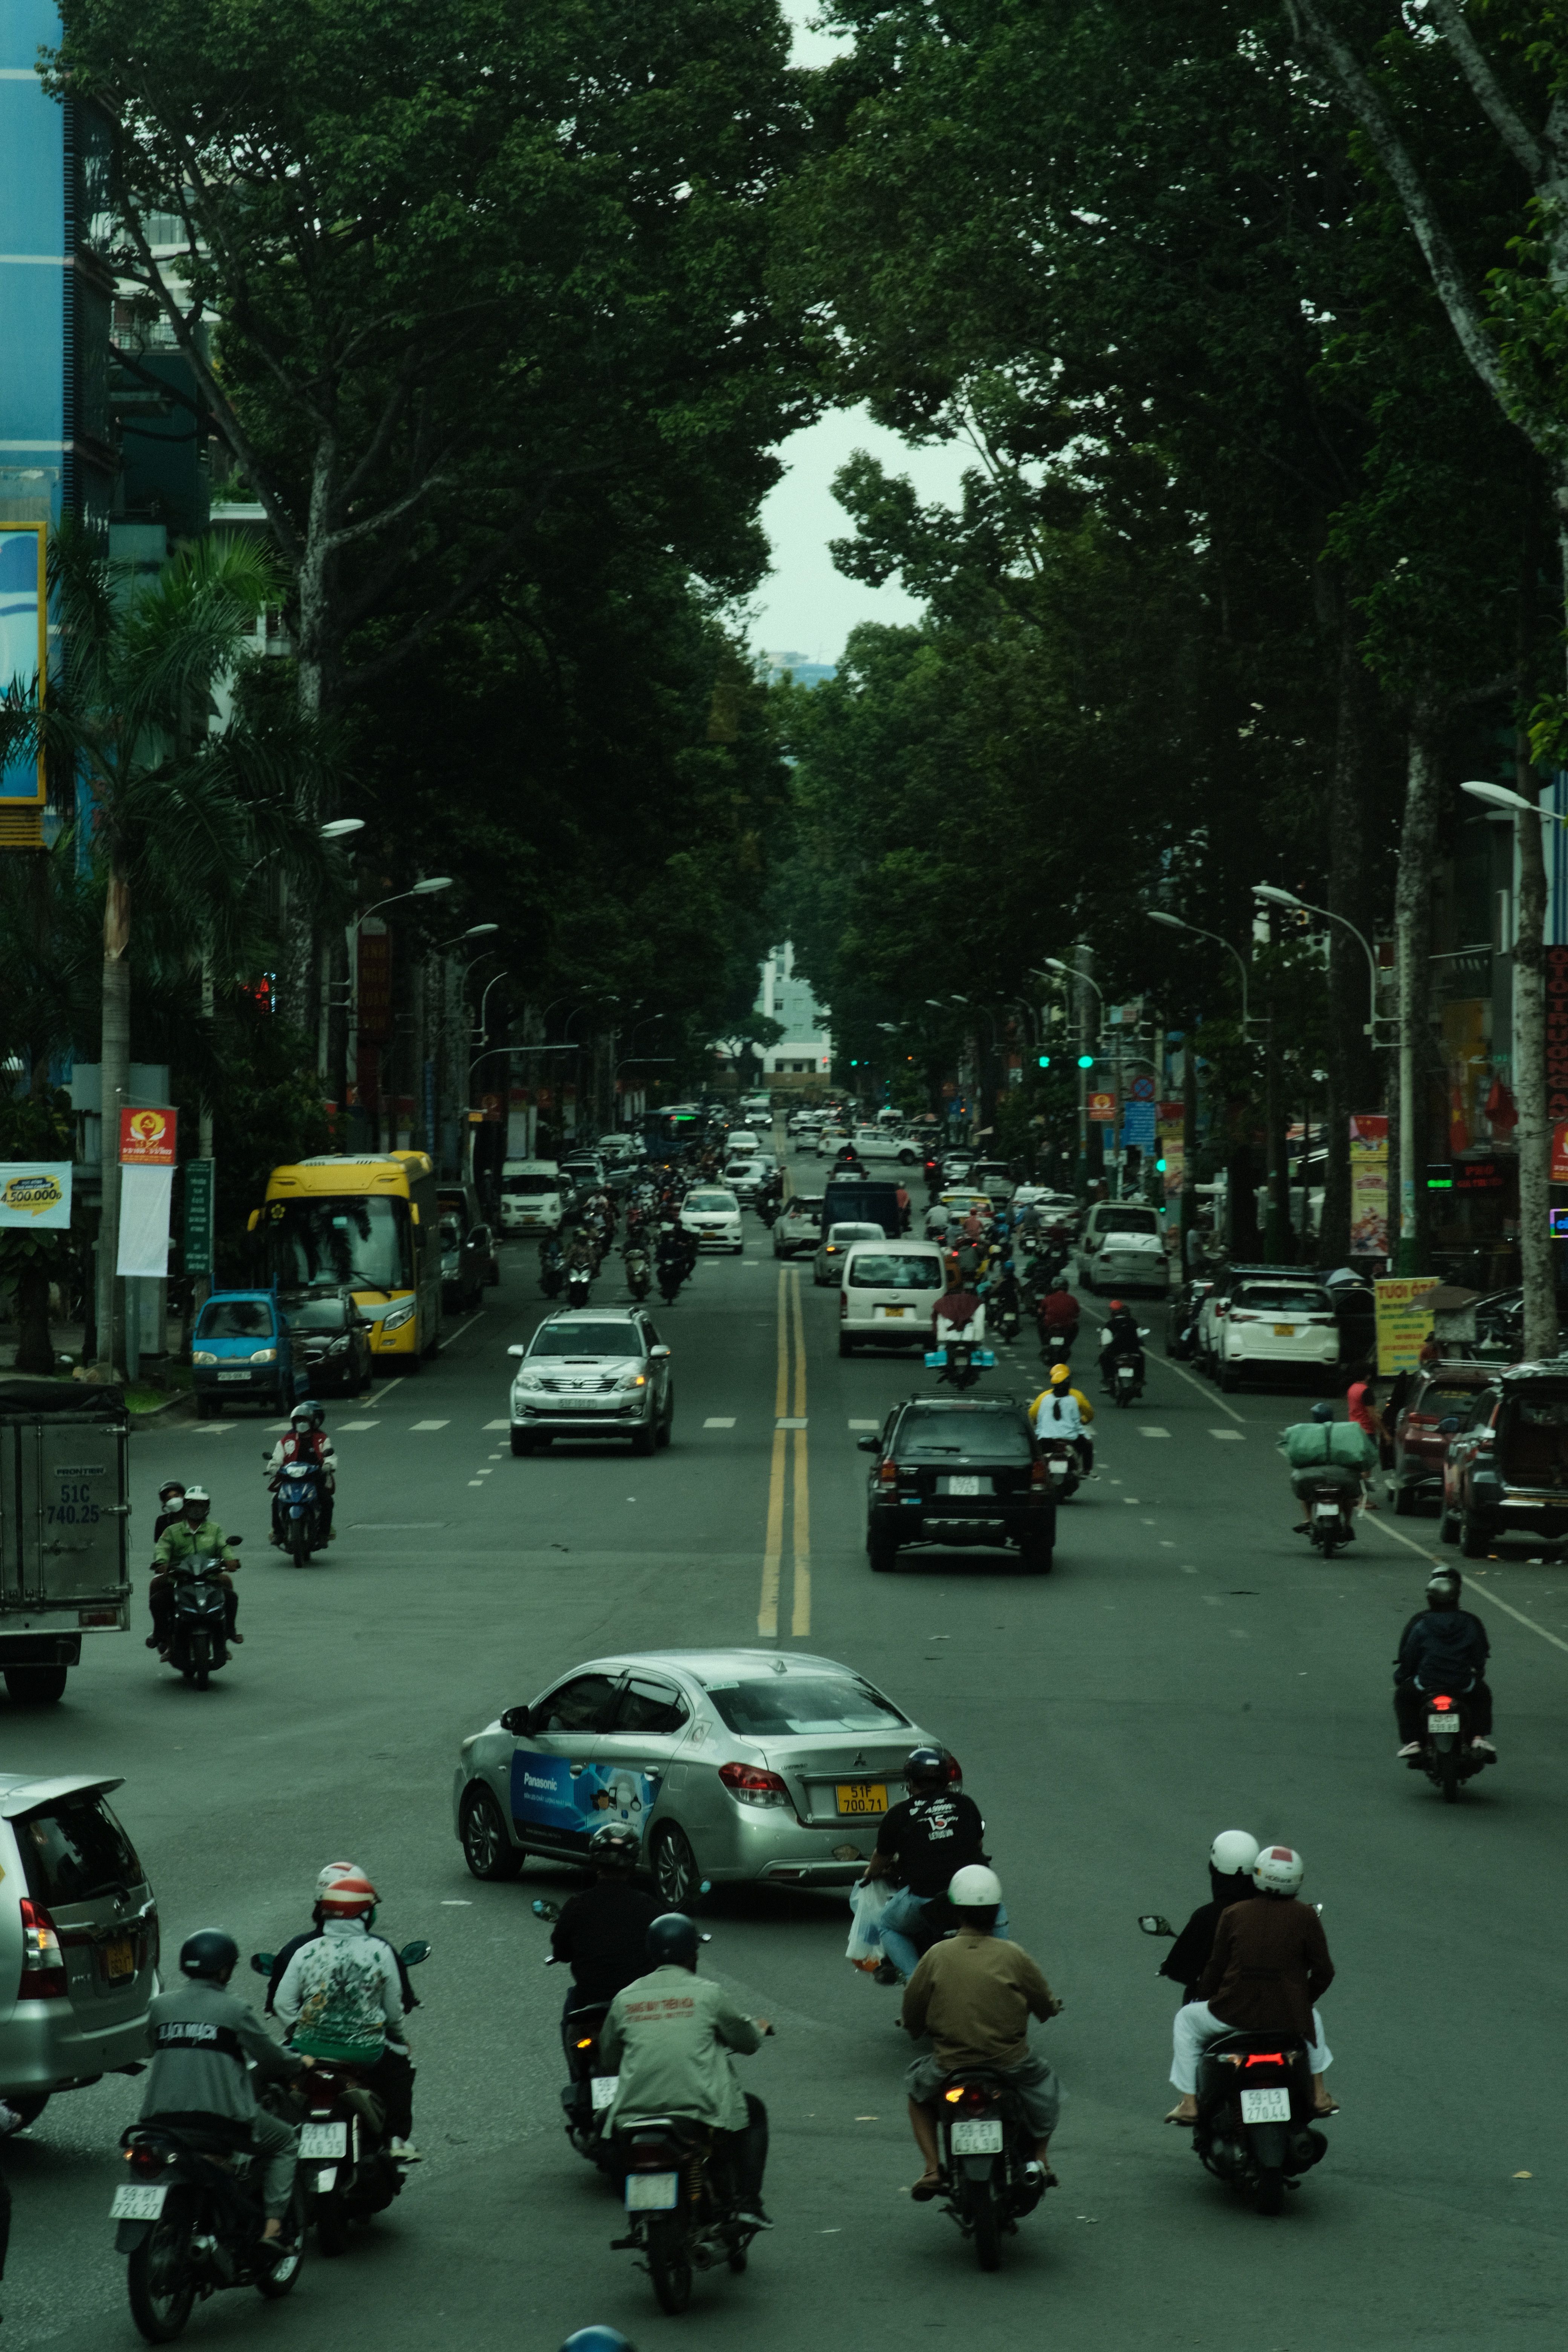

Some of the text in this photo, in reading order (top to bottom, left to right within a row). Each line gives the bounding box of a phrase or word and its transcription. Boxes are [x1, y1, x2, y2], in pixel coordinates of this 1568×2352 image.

[61, 1484, 90, 1503] 51C
[47, 1505, 99, 1524] 740.25
[524, 1772, 557, 1791] Panasonic
[851, 1786, 871, 1798] 51F
[844, 1799, 882, 1811] 700.71
